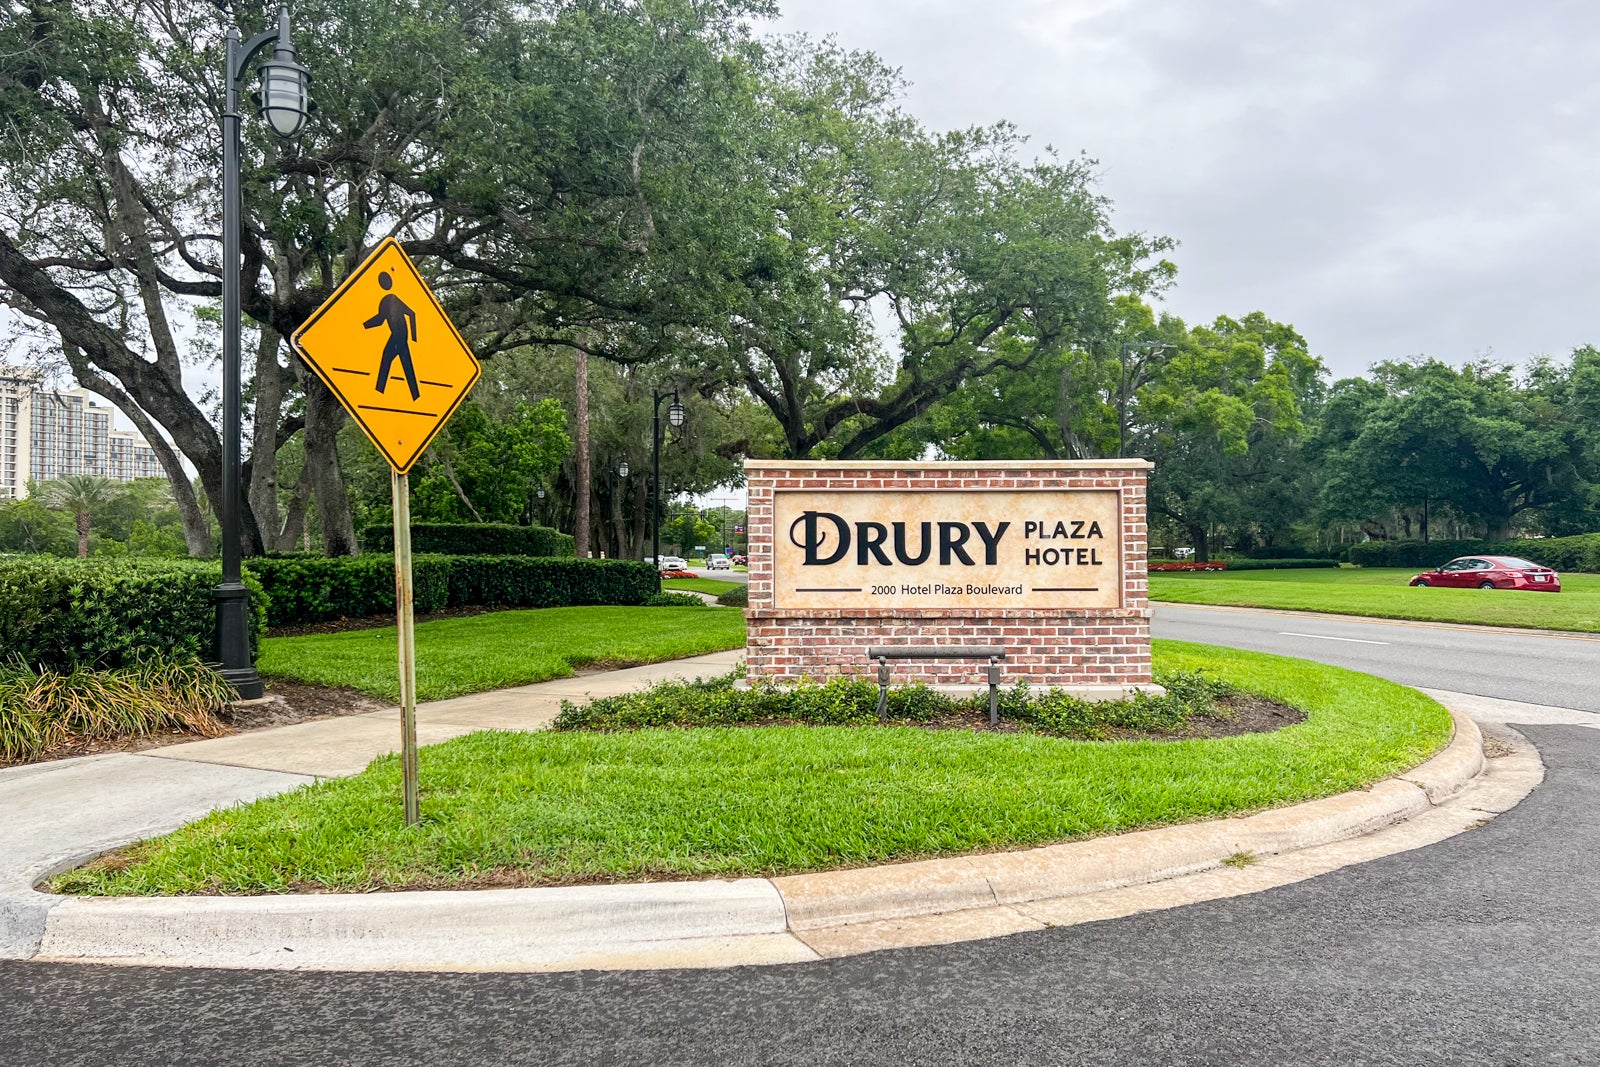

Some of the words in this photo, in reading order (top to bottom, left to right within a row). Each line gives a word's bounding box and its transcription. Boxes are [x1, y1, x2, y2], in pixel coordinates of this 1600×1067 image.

[789, 510, 1011, 566] DRURY
[1024, 520, 1104, 539] PLAZA
[1025, 547, 1103, 566] HOTEL
[871, 585, 897, 595] 2000
[901, 584, 931, 595] Hotel
[934, 584, 964, 595] Plaza
[966, 583, 1023, 595] Boulevard
